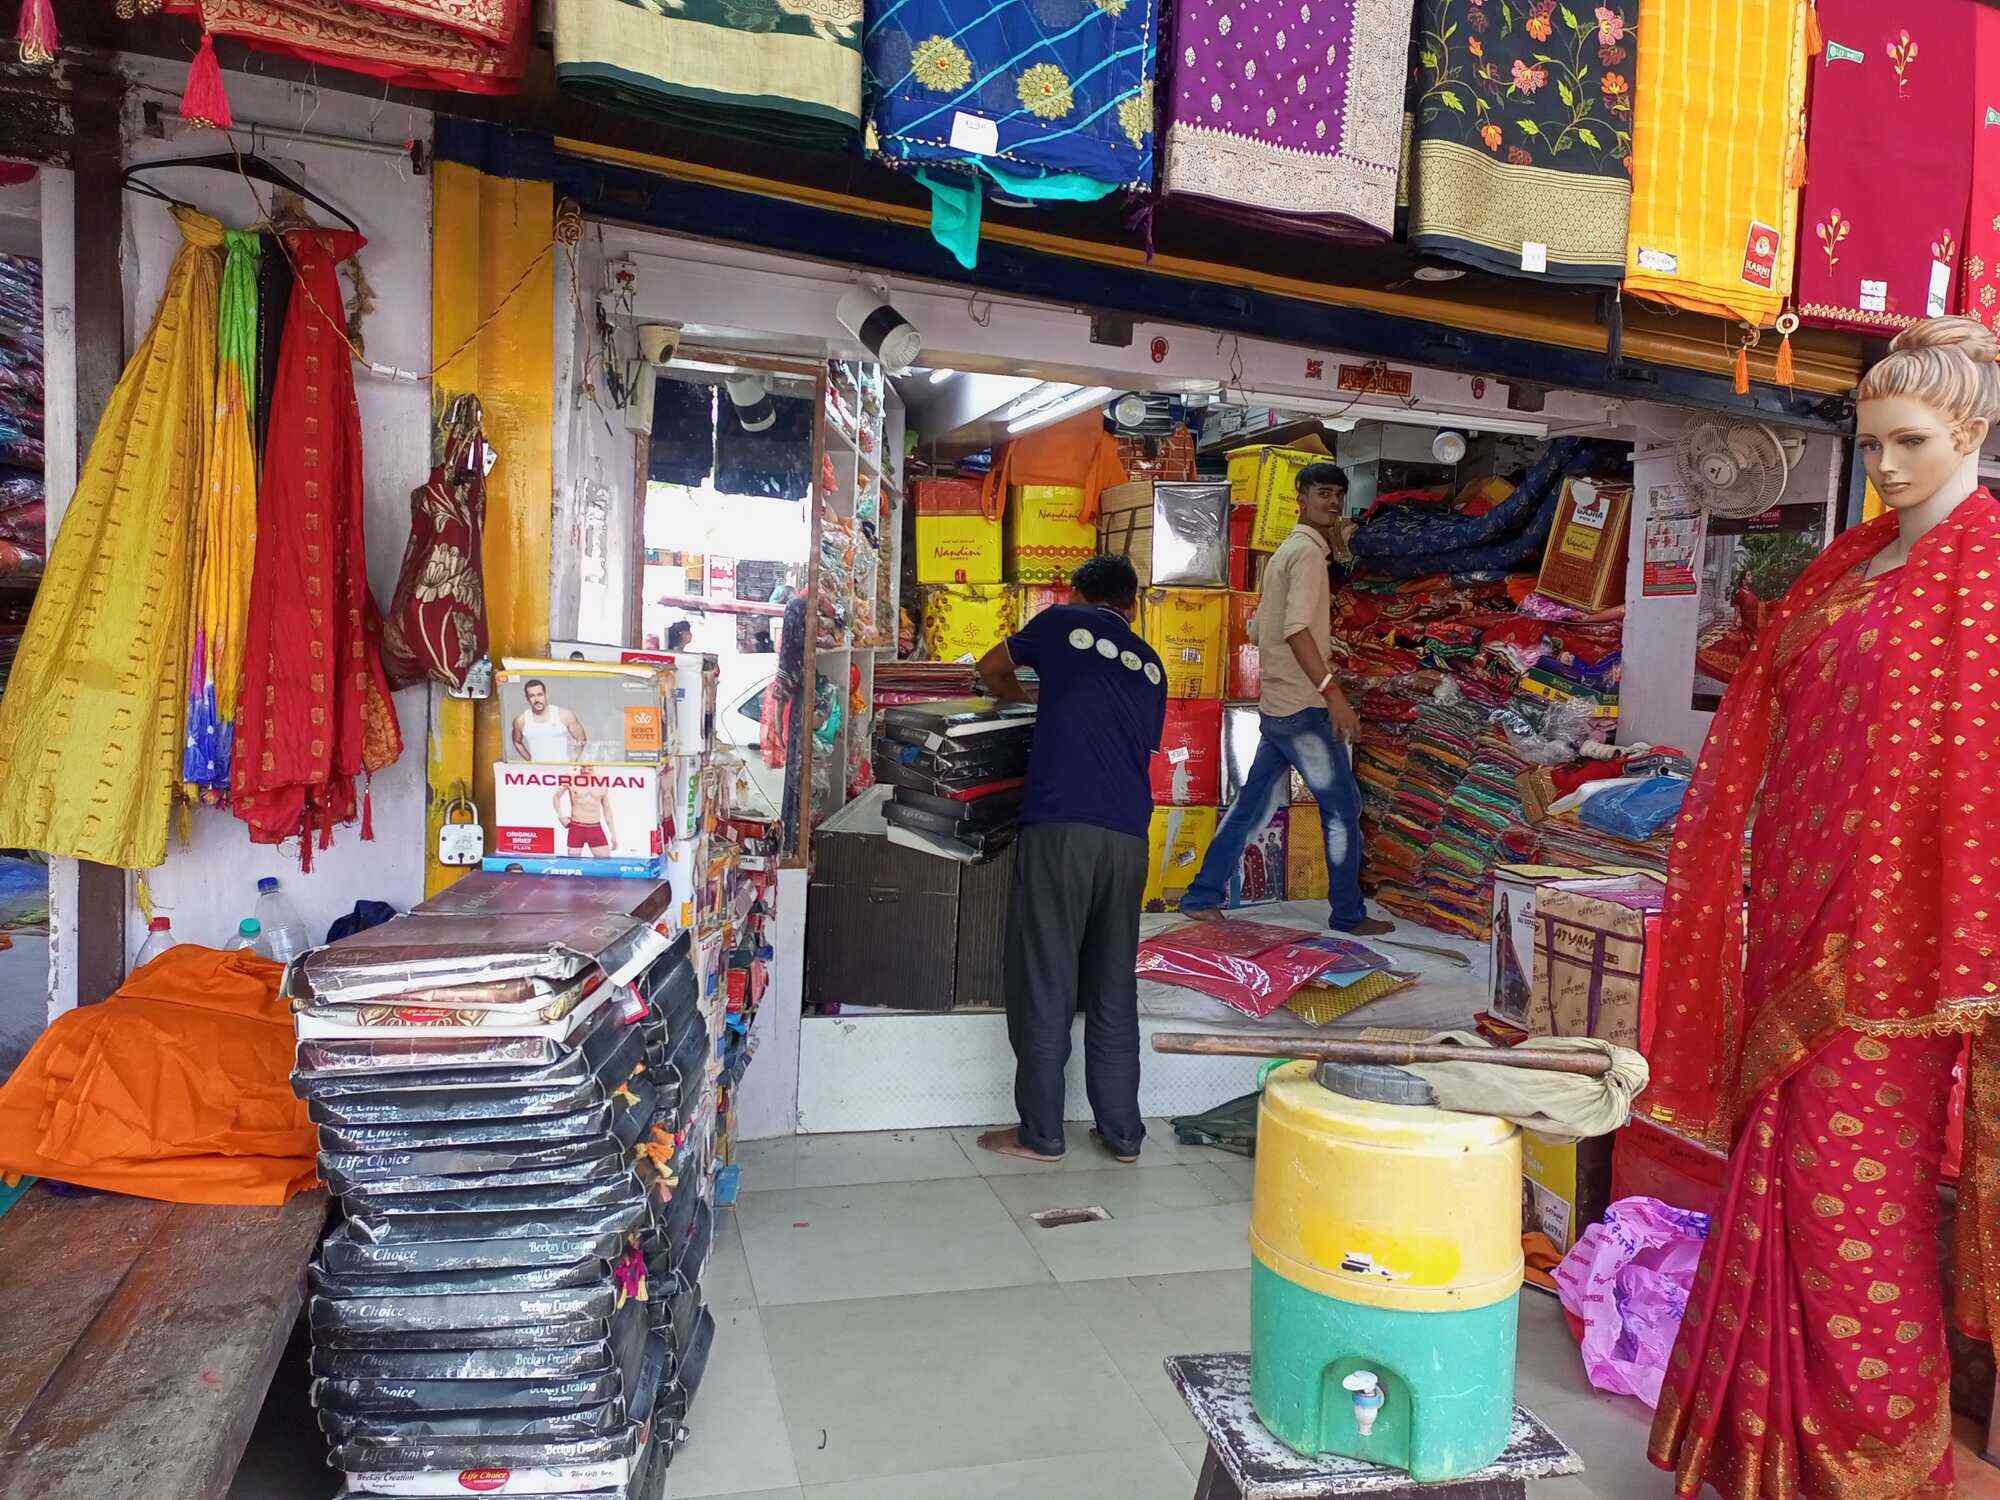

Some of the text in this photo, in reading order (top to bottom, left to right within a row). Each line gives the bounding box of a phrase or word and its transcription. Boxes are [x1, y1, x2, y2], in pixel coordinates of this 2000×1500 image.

[1746, 259, 1771, 277] KARNI
[934, 545, 983, 559] Nandini
[504, 773, 646, 788] MACROMAN
[506, 831, 539, 839] ORIGINAL
[1553, 927, 1594, 949] ATYAM
[337, 1154, 411, 1171] Life Choice
[528, 1240, 597, 1254] Beekay Creation
[372, 1247, 418, 1263] Choice
[359, 1304, 406, 1318] Choice
[520, 1300, 553, 1313] Beekay
[514, 1353, 546, 1366] Beekay
[383, 1471, 415, 1482] Creation
[461, 1470, 508, 1482] Life Choice
